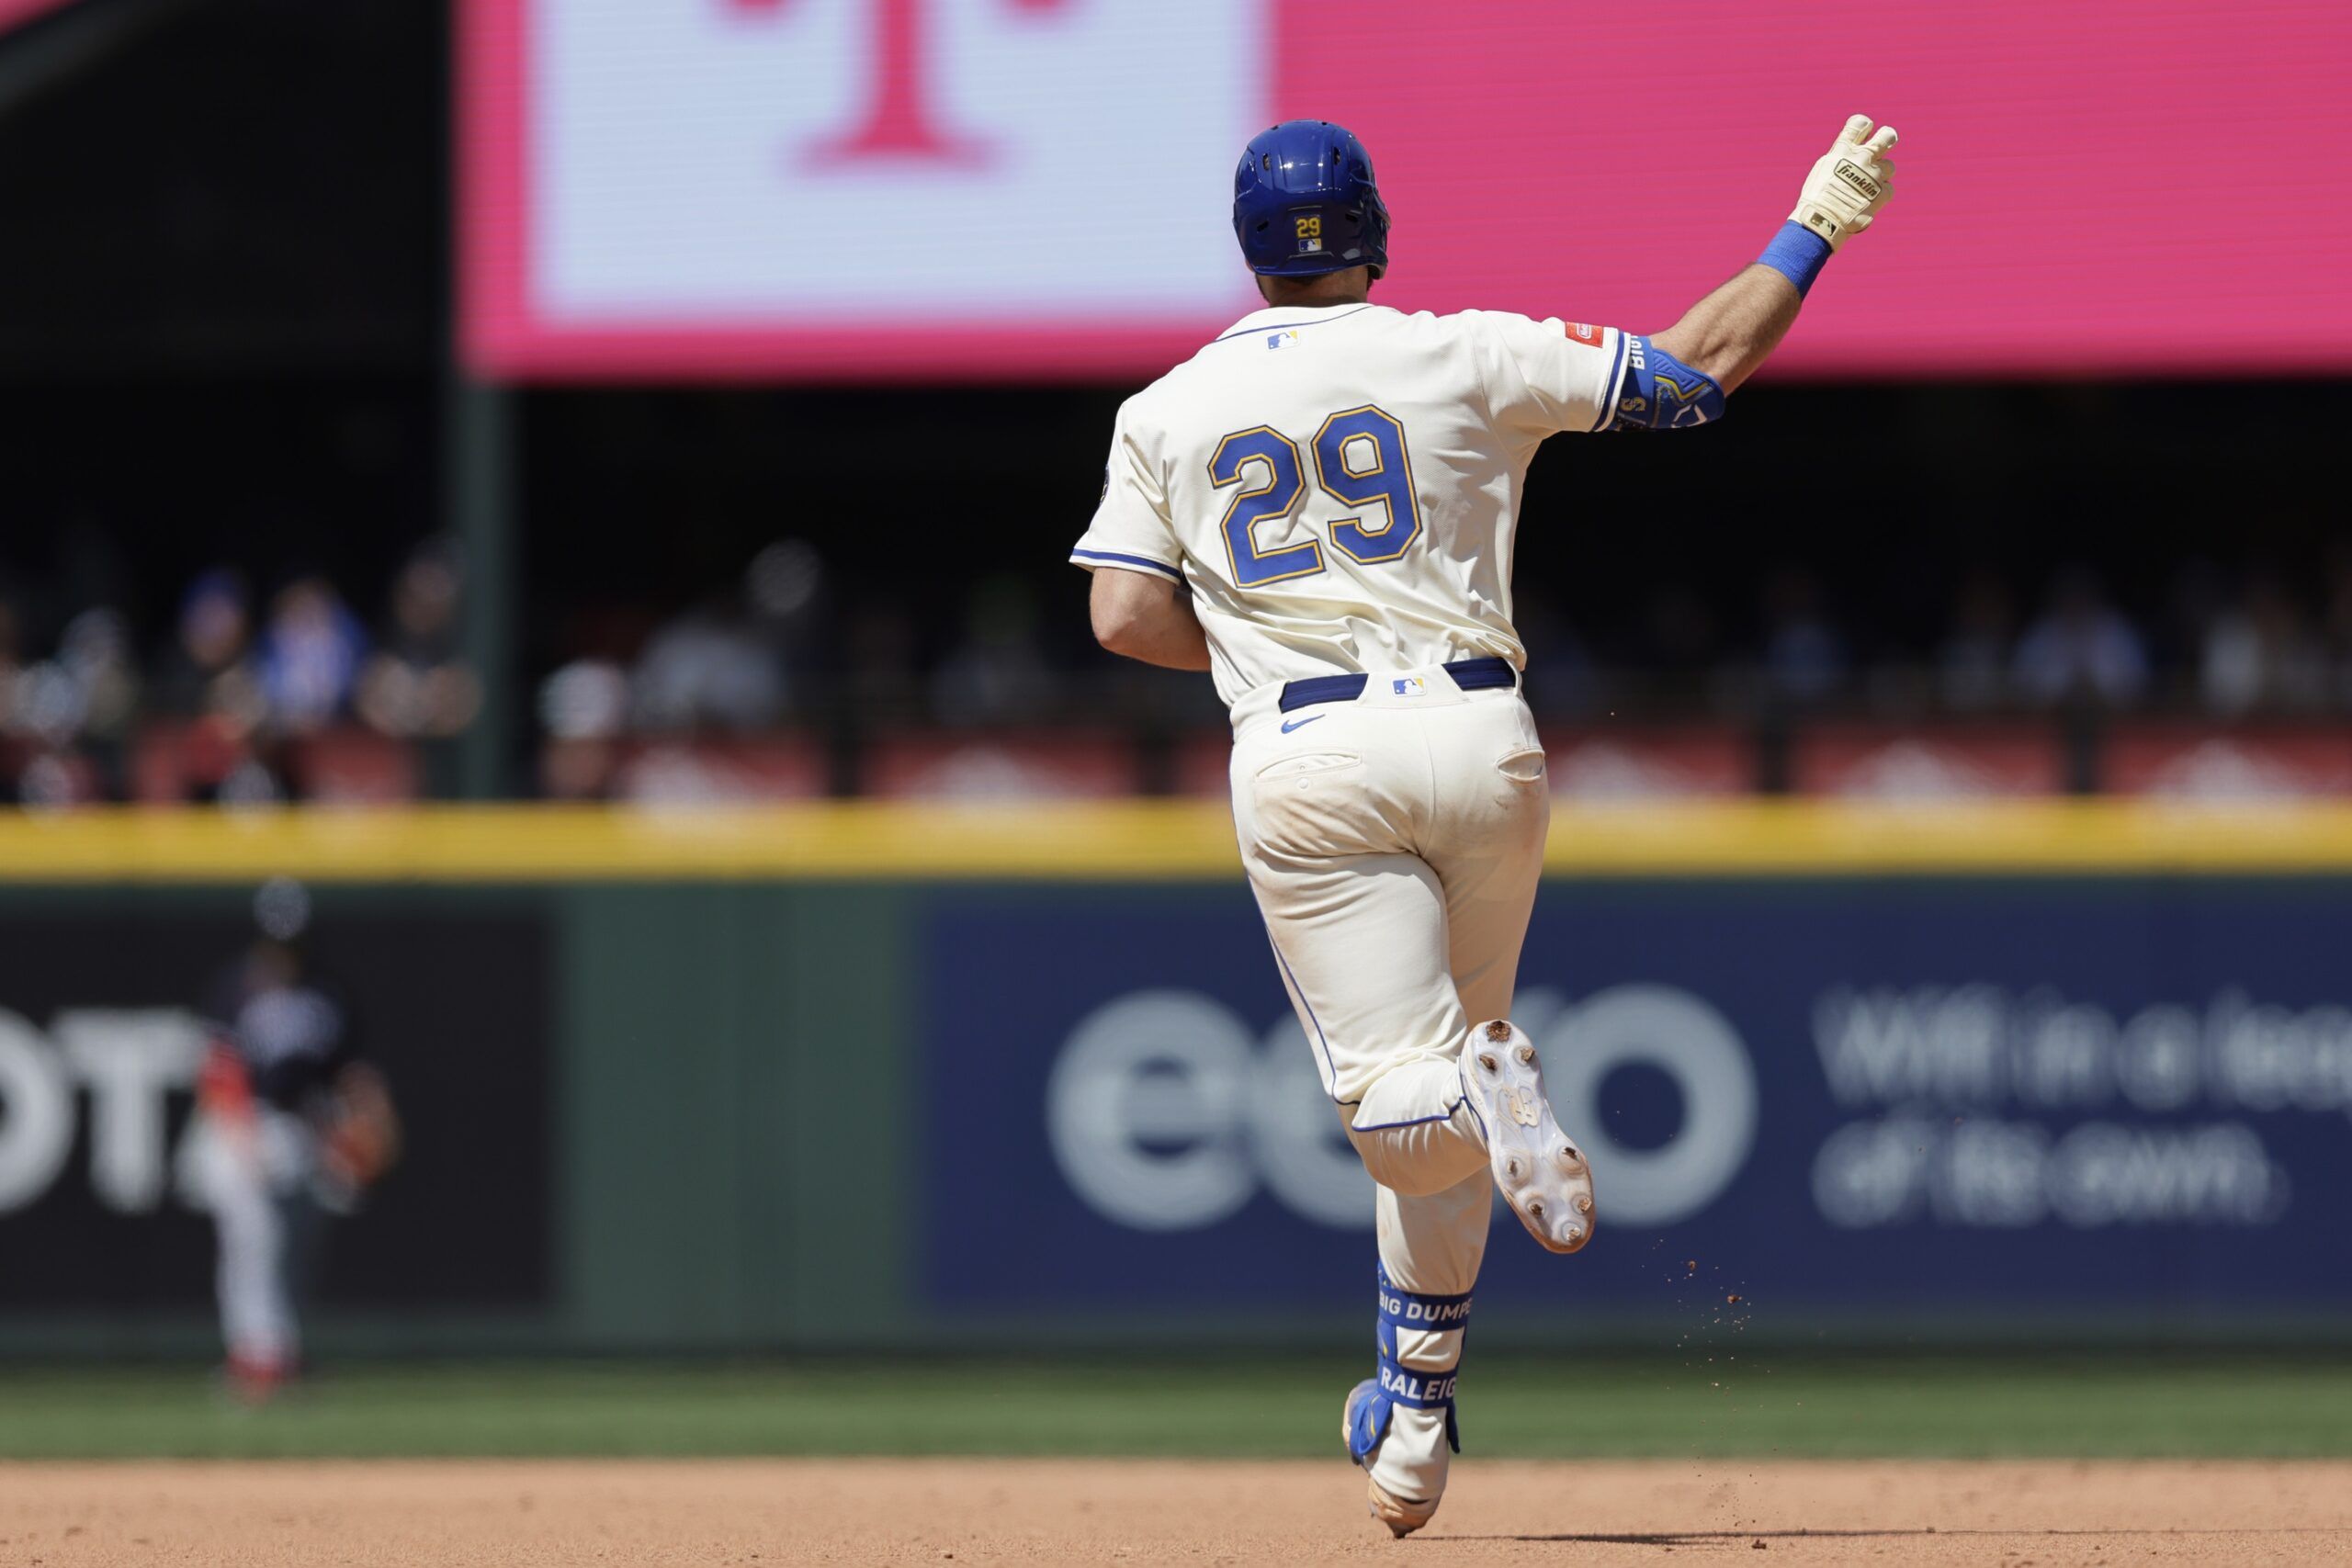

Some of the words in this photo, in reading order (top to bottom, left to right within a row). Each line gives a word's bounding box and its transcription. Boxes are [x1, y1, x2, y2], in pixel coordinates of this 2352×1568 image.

[1295, 217, 1321, 238] 29
[1206, 404, 1423, 588] 29
[1046, 988, 1757, 1229] eo
[1379, 1290, 1401, 1315] BIG
